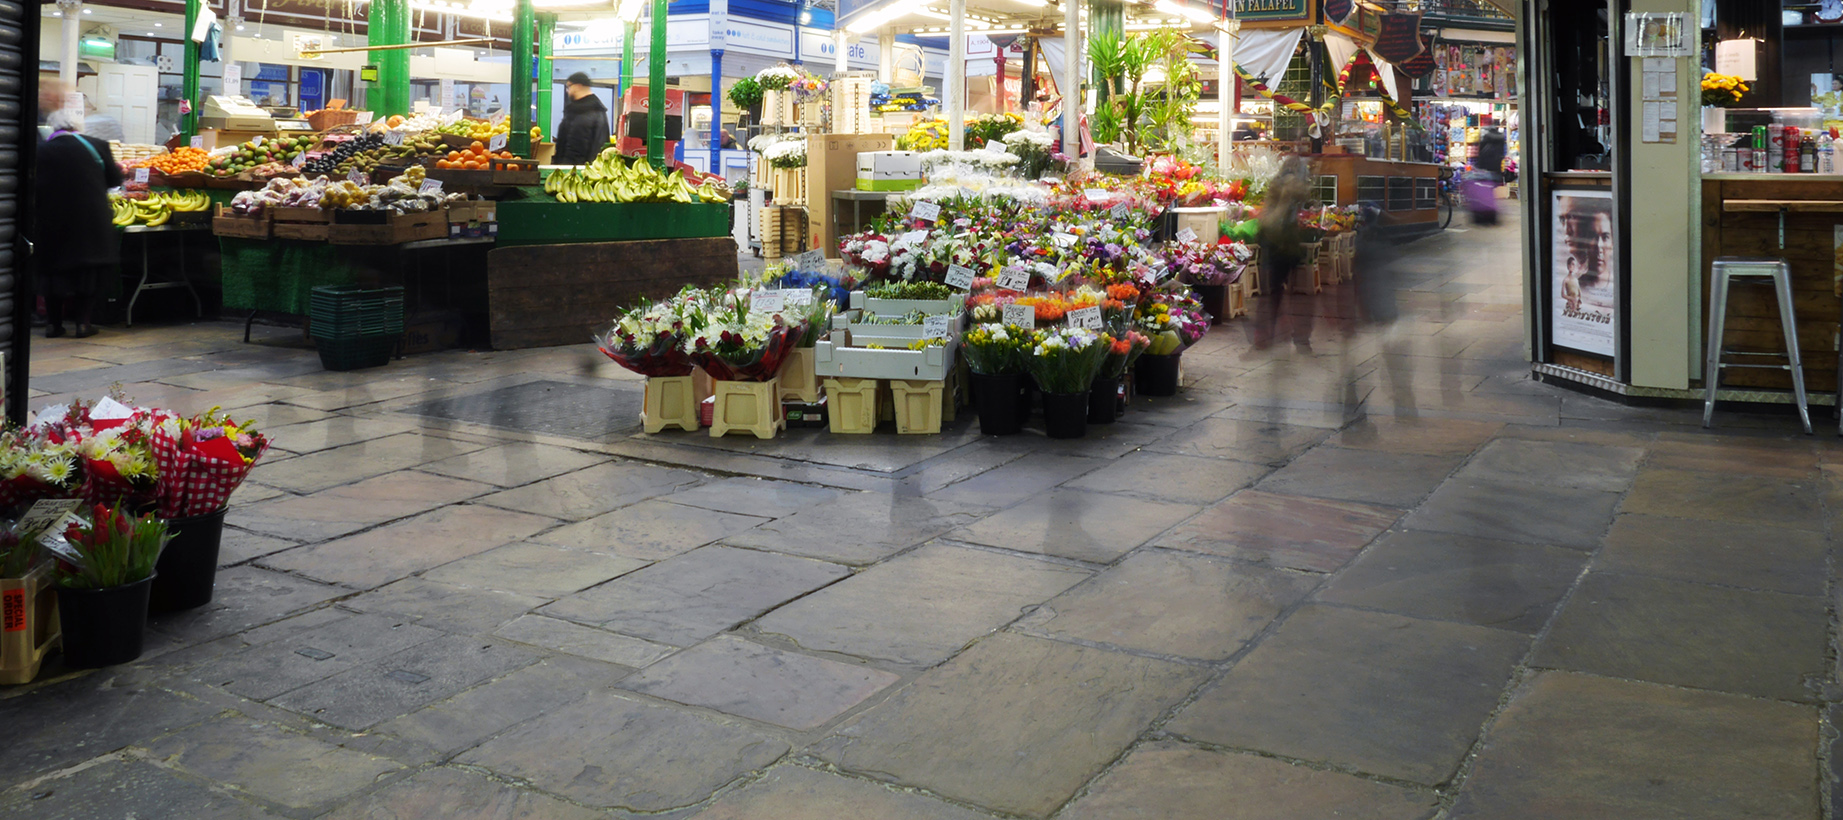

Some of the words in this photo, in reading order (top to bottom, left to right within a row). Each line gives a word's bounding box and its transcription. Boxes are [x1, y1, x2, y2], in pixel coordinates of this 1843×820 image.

[1248, 0, 1297, 12] FALAFEL
[3, 594, 14, 630] ORDER
[14, 594, 24, 628] SPECIAL
